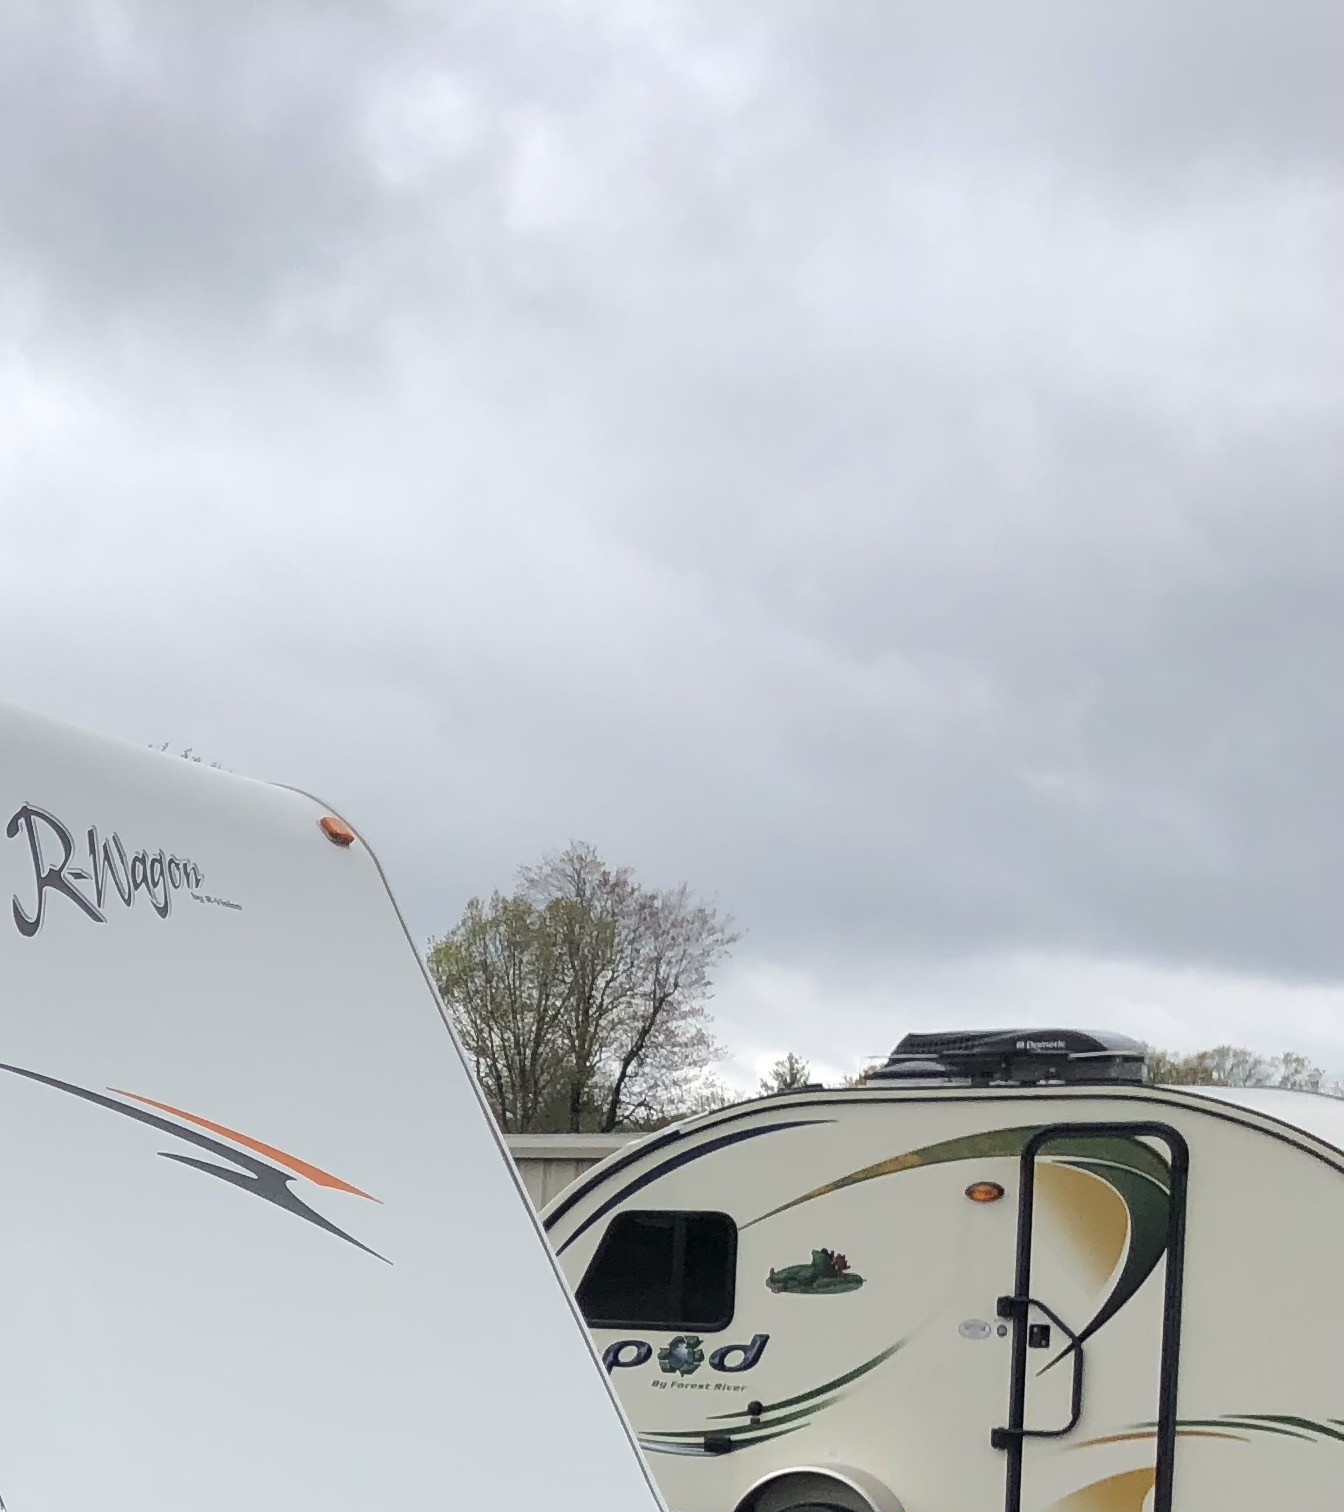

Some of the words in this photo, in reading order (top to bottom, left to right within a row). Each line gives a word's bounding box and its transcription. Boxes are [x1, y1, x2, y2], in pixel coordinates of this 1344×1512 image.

[6, 801, 205, 937] R-Wagon
[670, 1381, 710, 1391] Forest
[713, 1383, 747, 1392] River
